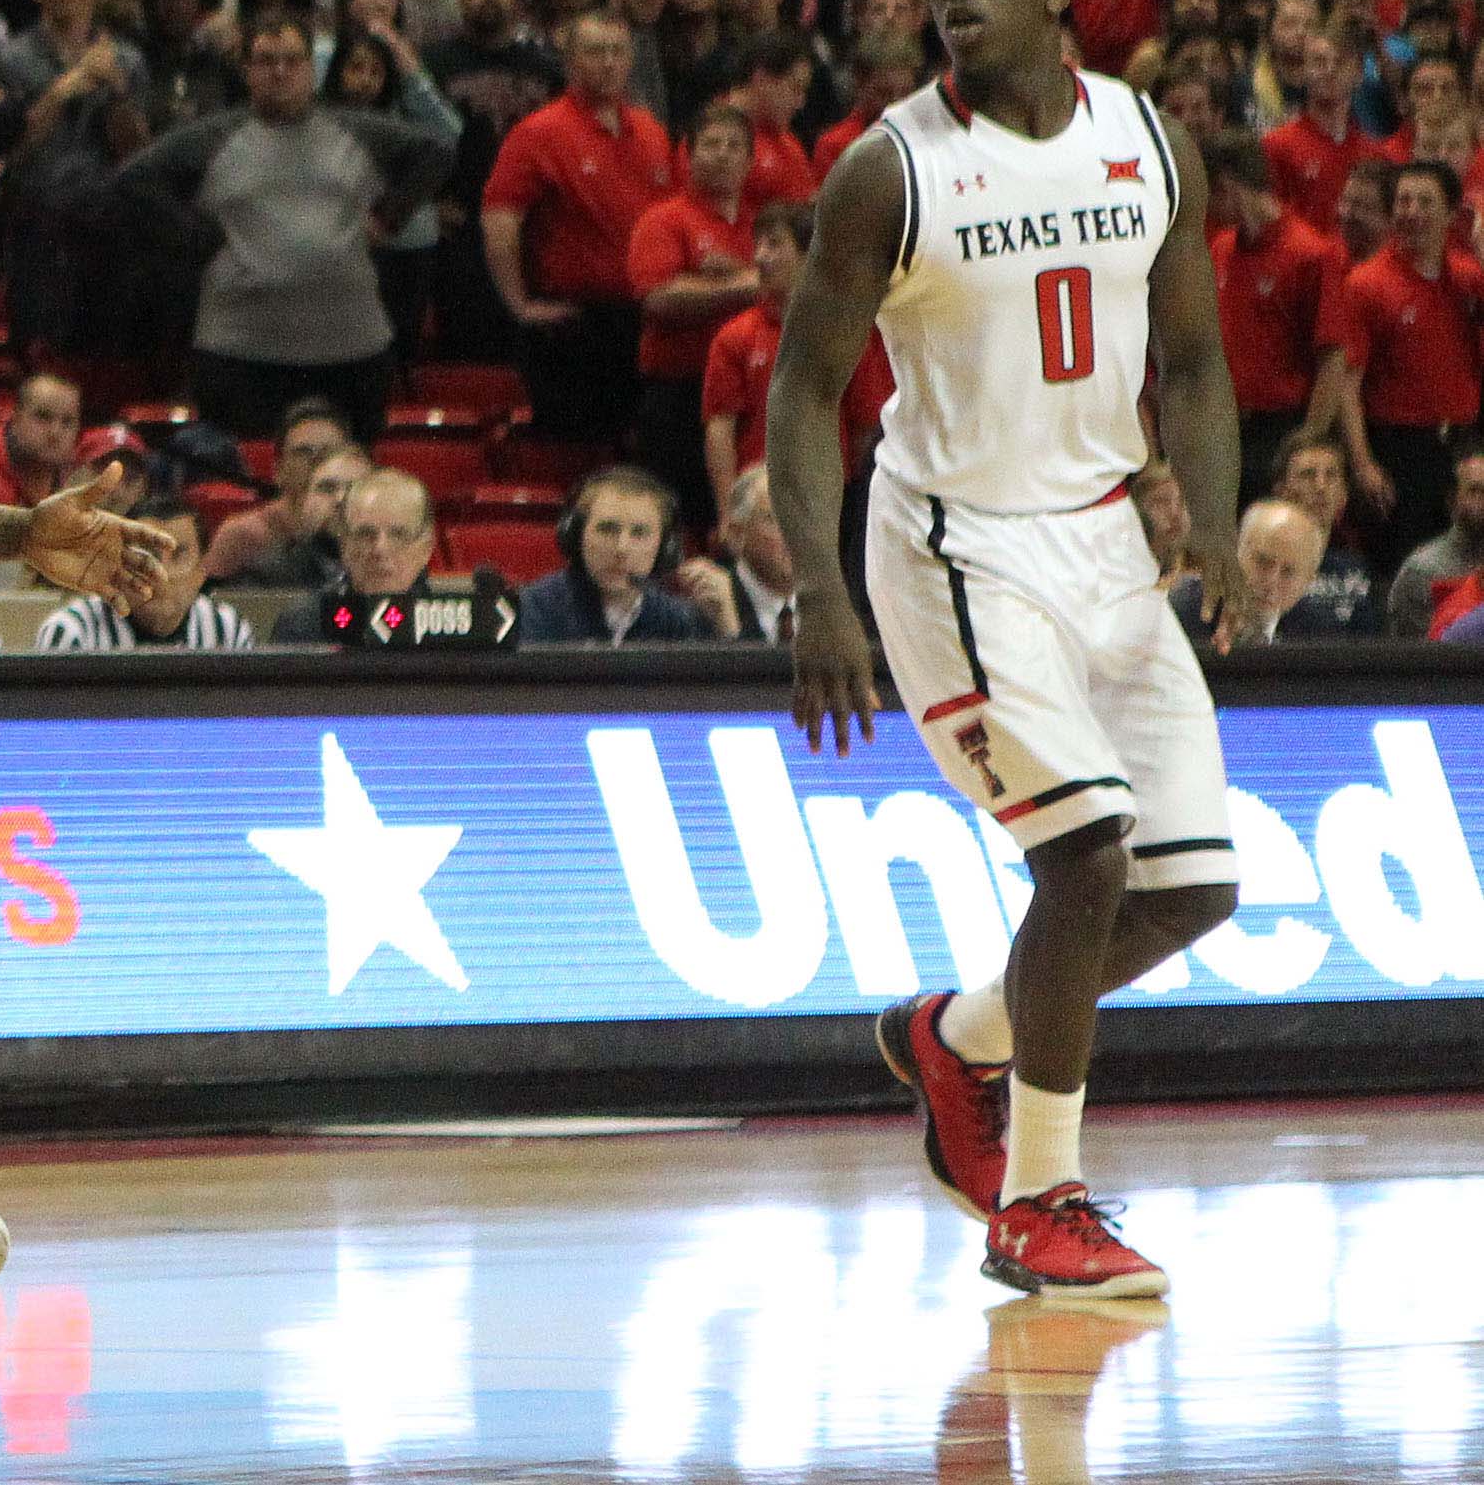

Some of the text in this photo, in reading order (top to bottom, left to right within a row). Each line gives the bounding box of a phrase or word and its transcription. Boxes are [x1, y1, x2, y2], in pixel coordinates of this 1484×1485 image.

[955, 204, 1147, 263] TEXAS TECH
[1035, 266, 1095, 383] 0
[585, 719, 1484, 1008] Uned
